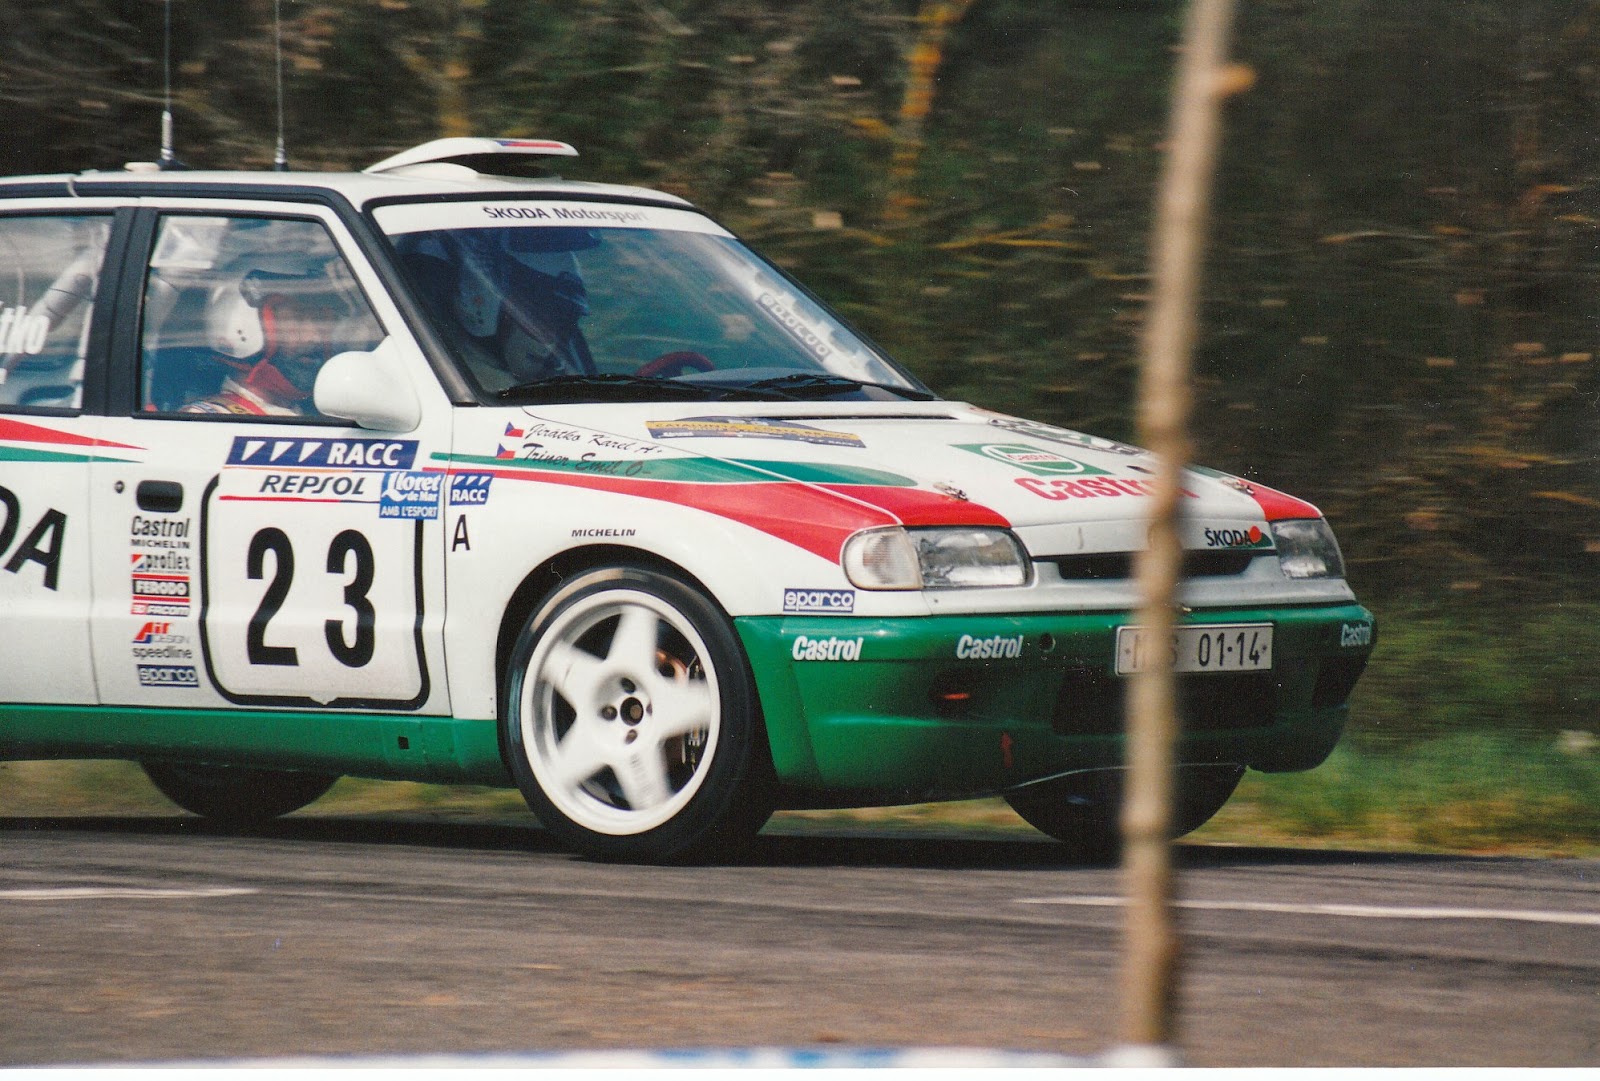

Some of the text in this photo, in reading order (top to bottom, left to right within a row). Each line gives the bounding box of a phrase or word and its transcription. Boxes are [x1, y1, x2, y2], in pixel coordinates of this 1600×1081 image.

[553, 207, 649, 223] Motorsport
[326, 443, 403, 466] RACC
[522, 443, 569, 467] Triner
[259, 475, 366, 496] REPSOL
[382, 471, 441, 501] Lloret
[451, 489, 487, 502] RACC
[1013, 475, 1200, 501] Castrl
[381, 505, 438, 517] AMB L'ESPORT
[131, 515, 190, 537] Castrol
[452, 514, 470, 552] A
[571, 528, 637, 537] MICHELIN
[131, 539, 190, 549] MICHELIN
[135, 581, 188, 596] FERODO
[247, 527, 375, 668] 23
[784, 591, 854, 610] sparco
[132, 645, 193, 661] speedline
[791, 635, 864, 661] Castrol
[956, 633, 1024, 660] Castrol
[139, 667, 198, 685] sparco
